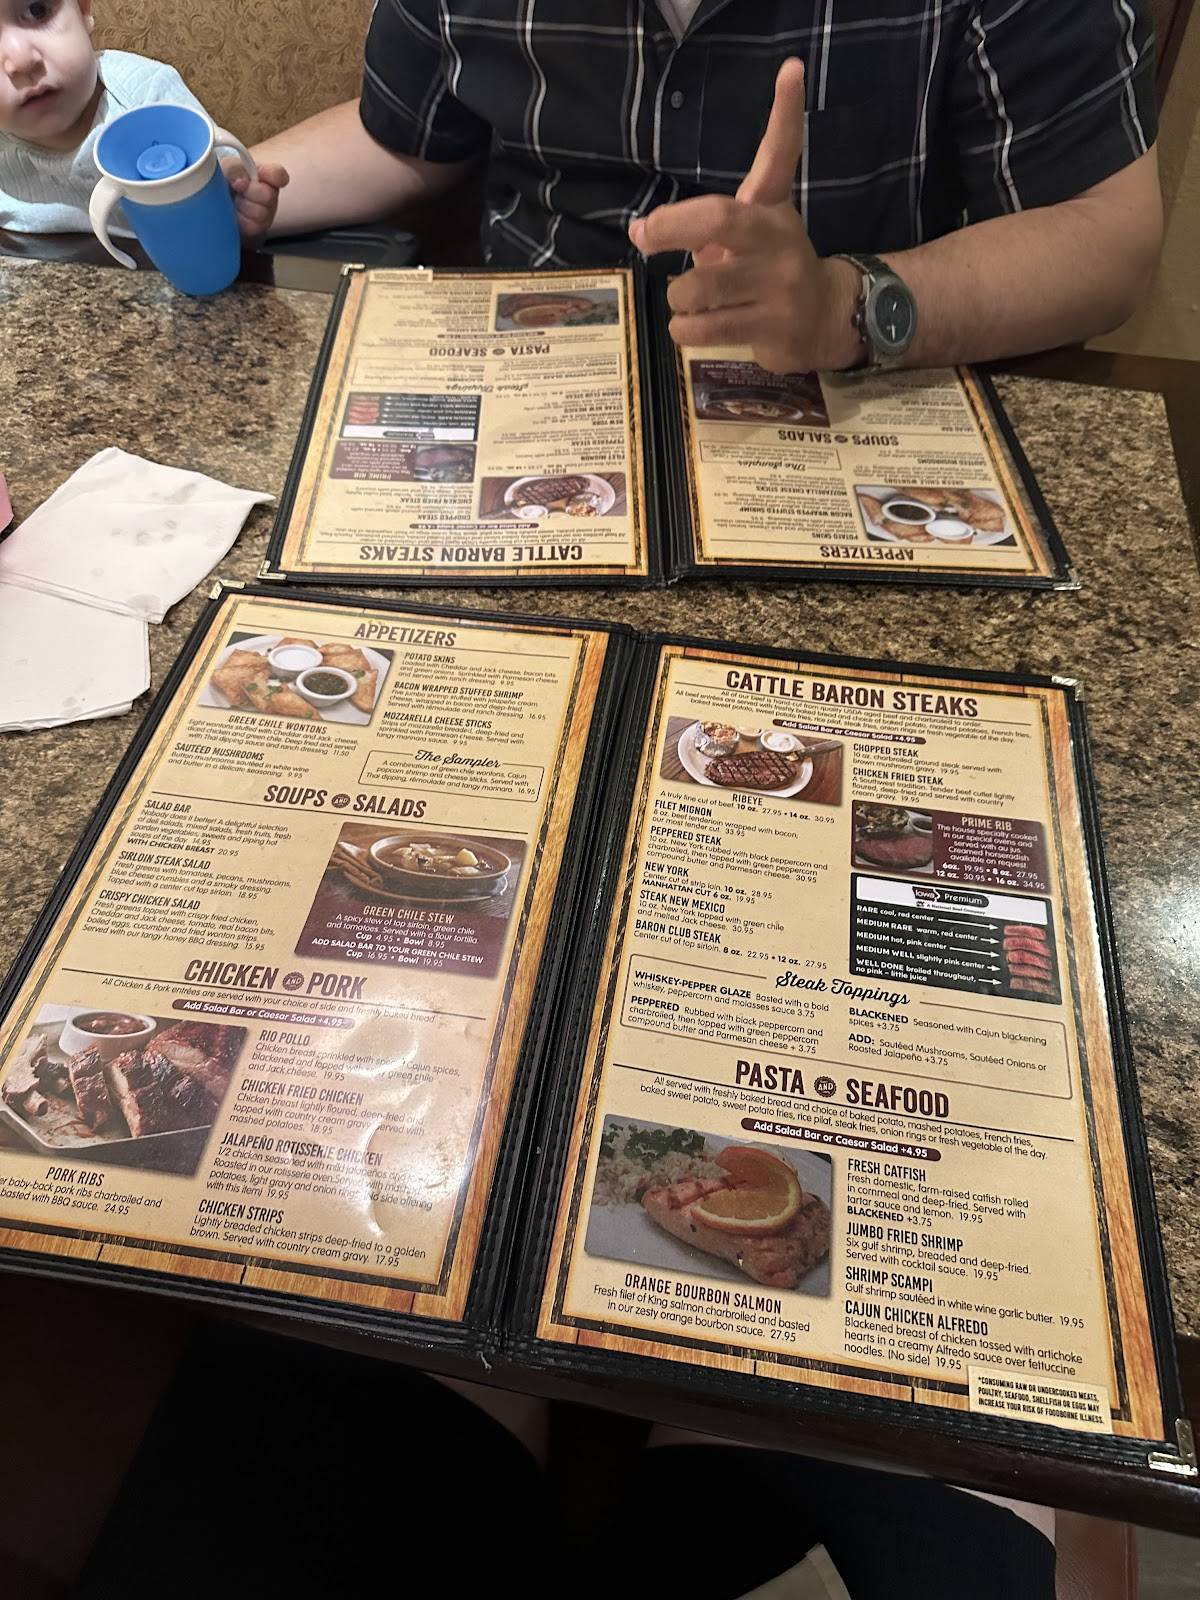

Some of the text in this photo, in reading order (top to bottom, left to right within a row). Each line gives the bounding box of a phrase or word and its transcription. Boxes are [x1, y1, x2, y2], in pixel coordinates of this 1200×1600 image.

[429, 344, 550, 357] PASTA SEAFOOD
[777, 429, 899, 446] SOUPS SALADS
[439, 512, 471, 521] CHOPPED
[359, 544, 583, 563] CATTLE BARON STEAKS
[819, 544, 914, 561] APPETIZERS
[353, 623, 457, 648] APPETIZERS
[404, 652, 456, 664] POTATO SKINS
[394, 681, 524, 700] BACON WRAPPED STUFFED SHRIMP
[726, 670, 978, 718] CATTLE BARON STEAKS
[228, 714, 328, 735] GREEN CHILE WONTONS
[383, 711, 493, 729] MOZZARELLA CHEESE STICKS
[174, 742, 265, 761] SAUTÉED MUSHROOMS
[414, 749, 501, 769] The Sampler
[853, 743, 919, 758] CHOPPED STEAK
[852, 767, 944, 786] CHICKEN FRIED STEAK
[144, 799, 192, 814] SALAD BAR
[263, 784, 427, 819] SOUPS SALADS
[654, 799, 712, 818] FILET MIGNON
[732, 793, 763, 806] RIBEYE
[961, 816, 1012, 831] PRIME RIB
[650, 825, 722, 846] PEPPERED STEAK
[118, 850, 211, 870] SIRLOIN STEAK SALAD
[644, 861, 689, 878] NEW YORK
[98, 889, 201, 910] CRISPY CHICKEN SALAD
[639, 889, 726, 914] STEAK NEW MEXICO
[915, 889, 983, 905] Iowa Premium
[362, 905, 455, 925] GREEN CHILE STEW
[856, 904, 935, 922] RARE cool, red center
[635, 918, 722, 944] BARON CLUB STEAK
[856, 917, 978, 941] MEDIUM RARE warm, red center
[183, 959, 368, 999] CHICKEN AND PORK
[775, 970, 911, 1008] Steak Toppings
[848, 1018, 900, 1032] spices +3.75
[849, 1007, 909, 1024] BLACKENED
[955, 1025, 974, 1035] with
[975, 1027, 1000, 1038] Cajun
[1001, 1031, 1047, 1047] blackening
[259, 1029, 311, 1047] RIO POLLO
[848, 1032, 875, 1045] ADD:
[879, 1038, 914, 1052] Sautéed
[915, 1044, 968, 1061] Mushrooms,
[969, 1052, 1004, 1065] Sautéed
[1006, 1058, 1036, 1070] Onions
[848, 1042, 949, 1067] Roasted Jalapeño +3.75
[240, 1078, 365, 1106] CHICKEN FRIED CHICKEN
[735, 1060, 949, 1118] PASTA AND SEAFOOD
[220, 1131, 383, 1167] JALAPEÑO ROTISSERIE CHICKEN
[753, 1121, 928, 1158] Add Salad Bar or Caesar Salad +4.95
[45, 1166, 105, 1187] PORK RIBS
[848, 1158, 926, 1182] FRESH CATFISH
[198, 1198, 285, 1225] CHICKEN STRIPS
[847, 1205, 932, 1227] BLACKENED +3.75
[189, 1224, 400, 1268] brown. Served with country cream gravy. 17.95
[846, 1221, 963, 1252] JUMBO FRIED SHRIMP
[845, 1265, 933, 1293] SHRIMP SCAMPI
[624, 1273, 781, 1315] ORANGE BOURBON SALMON
[845, 1281, 1085, 1329] Gulf shrimp sautéed in white wine garlic butter. 19.95
[845, 1299, 988, 1336] CAJUN CHICKEN ALFREDO
